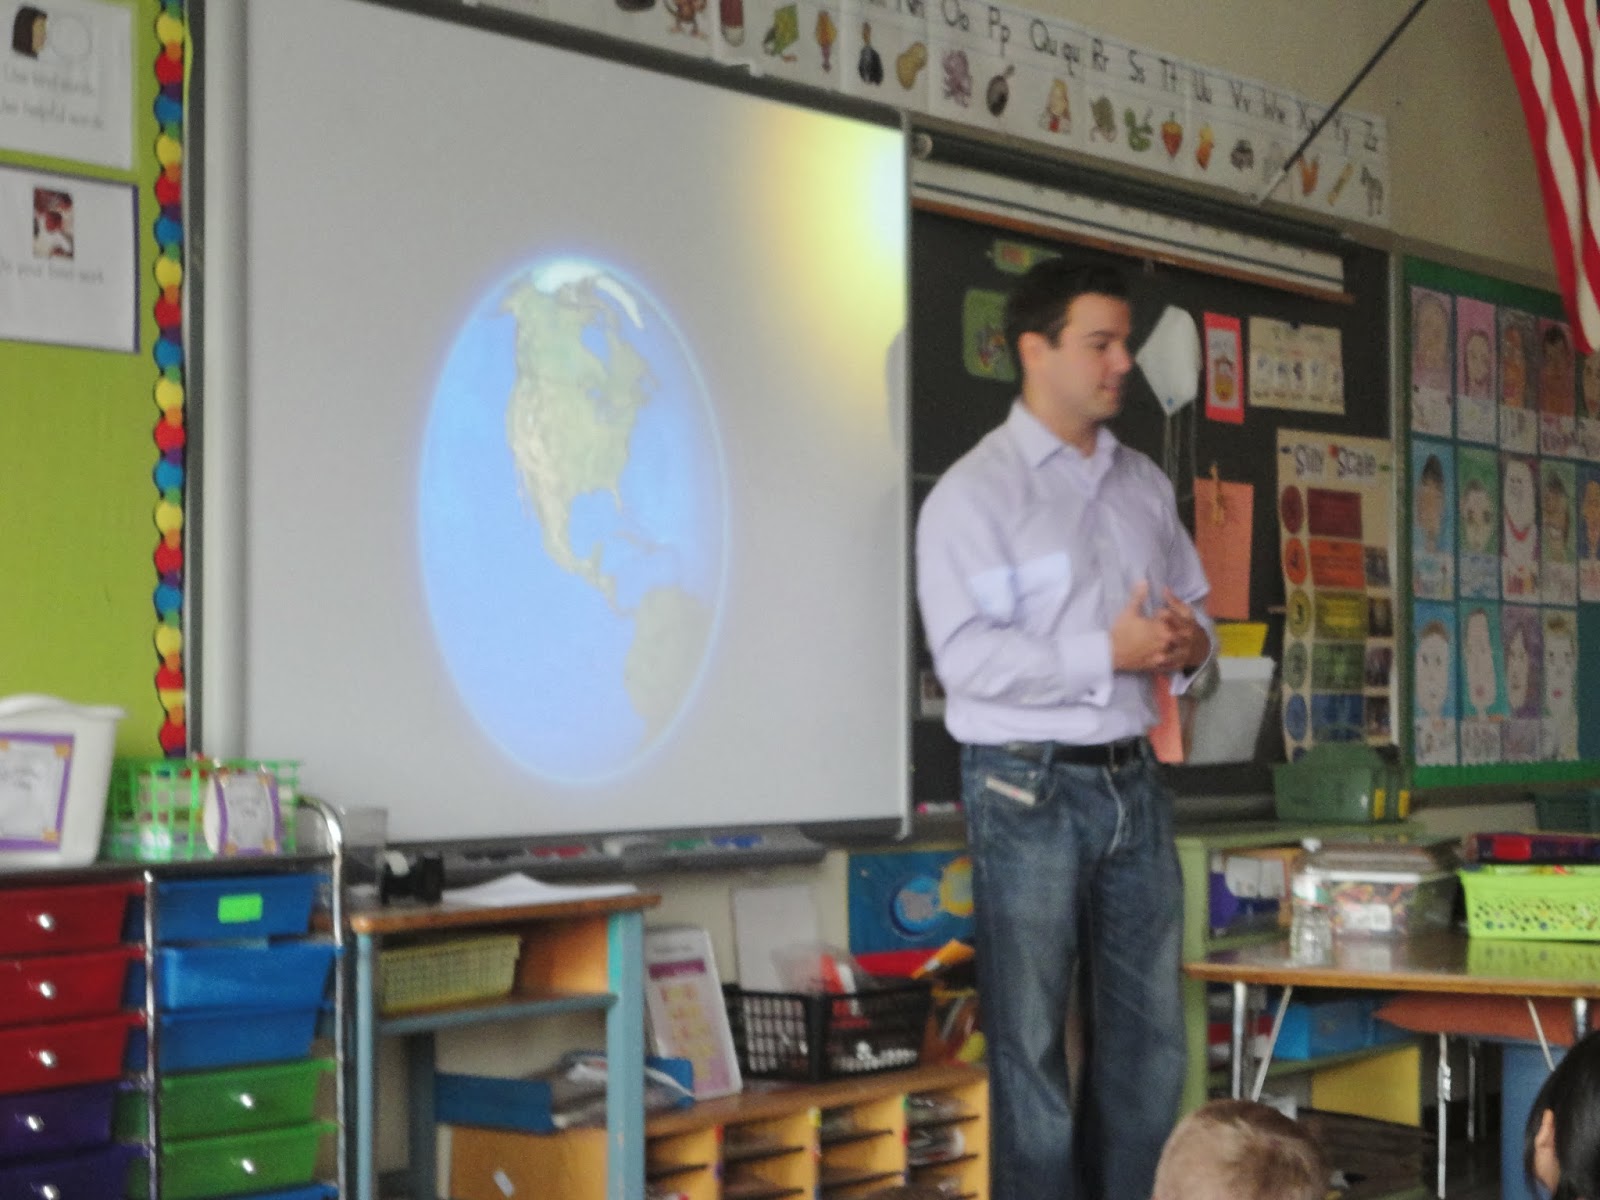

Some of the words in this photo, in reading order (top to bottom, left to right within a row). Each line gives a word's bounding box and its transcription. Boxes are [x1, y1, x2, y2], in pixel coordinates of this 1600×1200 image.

[988, 5, 1011, 58] Pp
[1091, 37, 1110, 72] Rr
[1127, 49, 1146, 84] Ss
[1158, 58, 1177, 93] Tt
